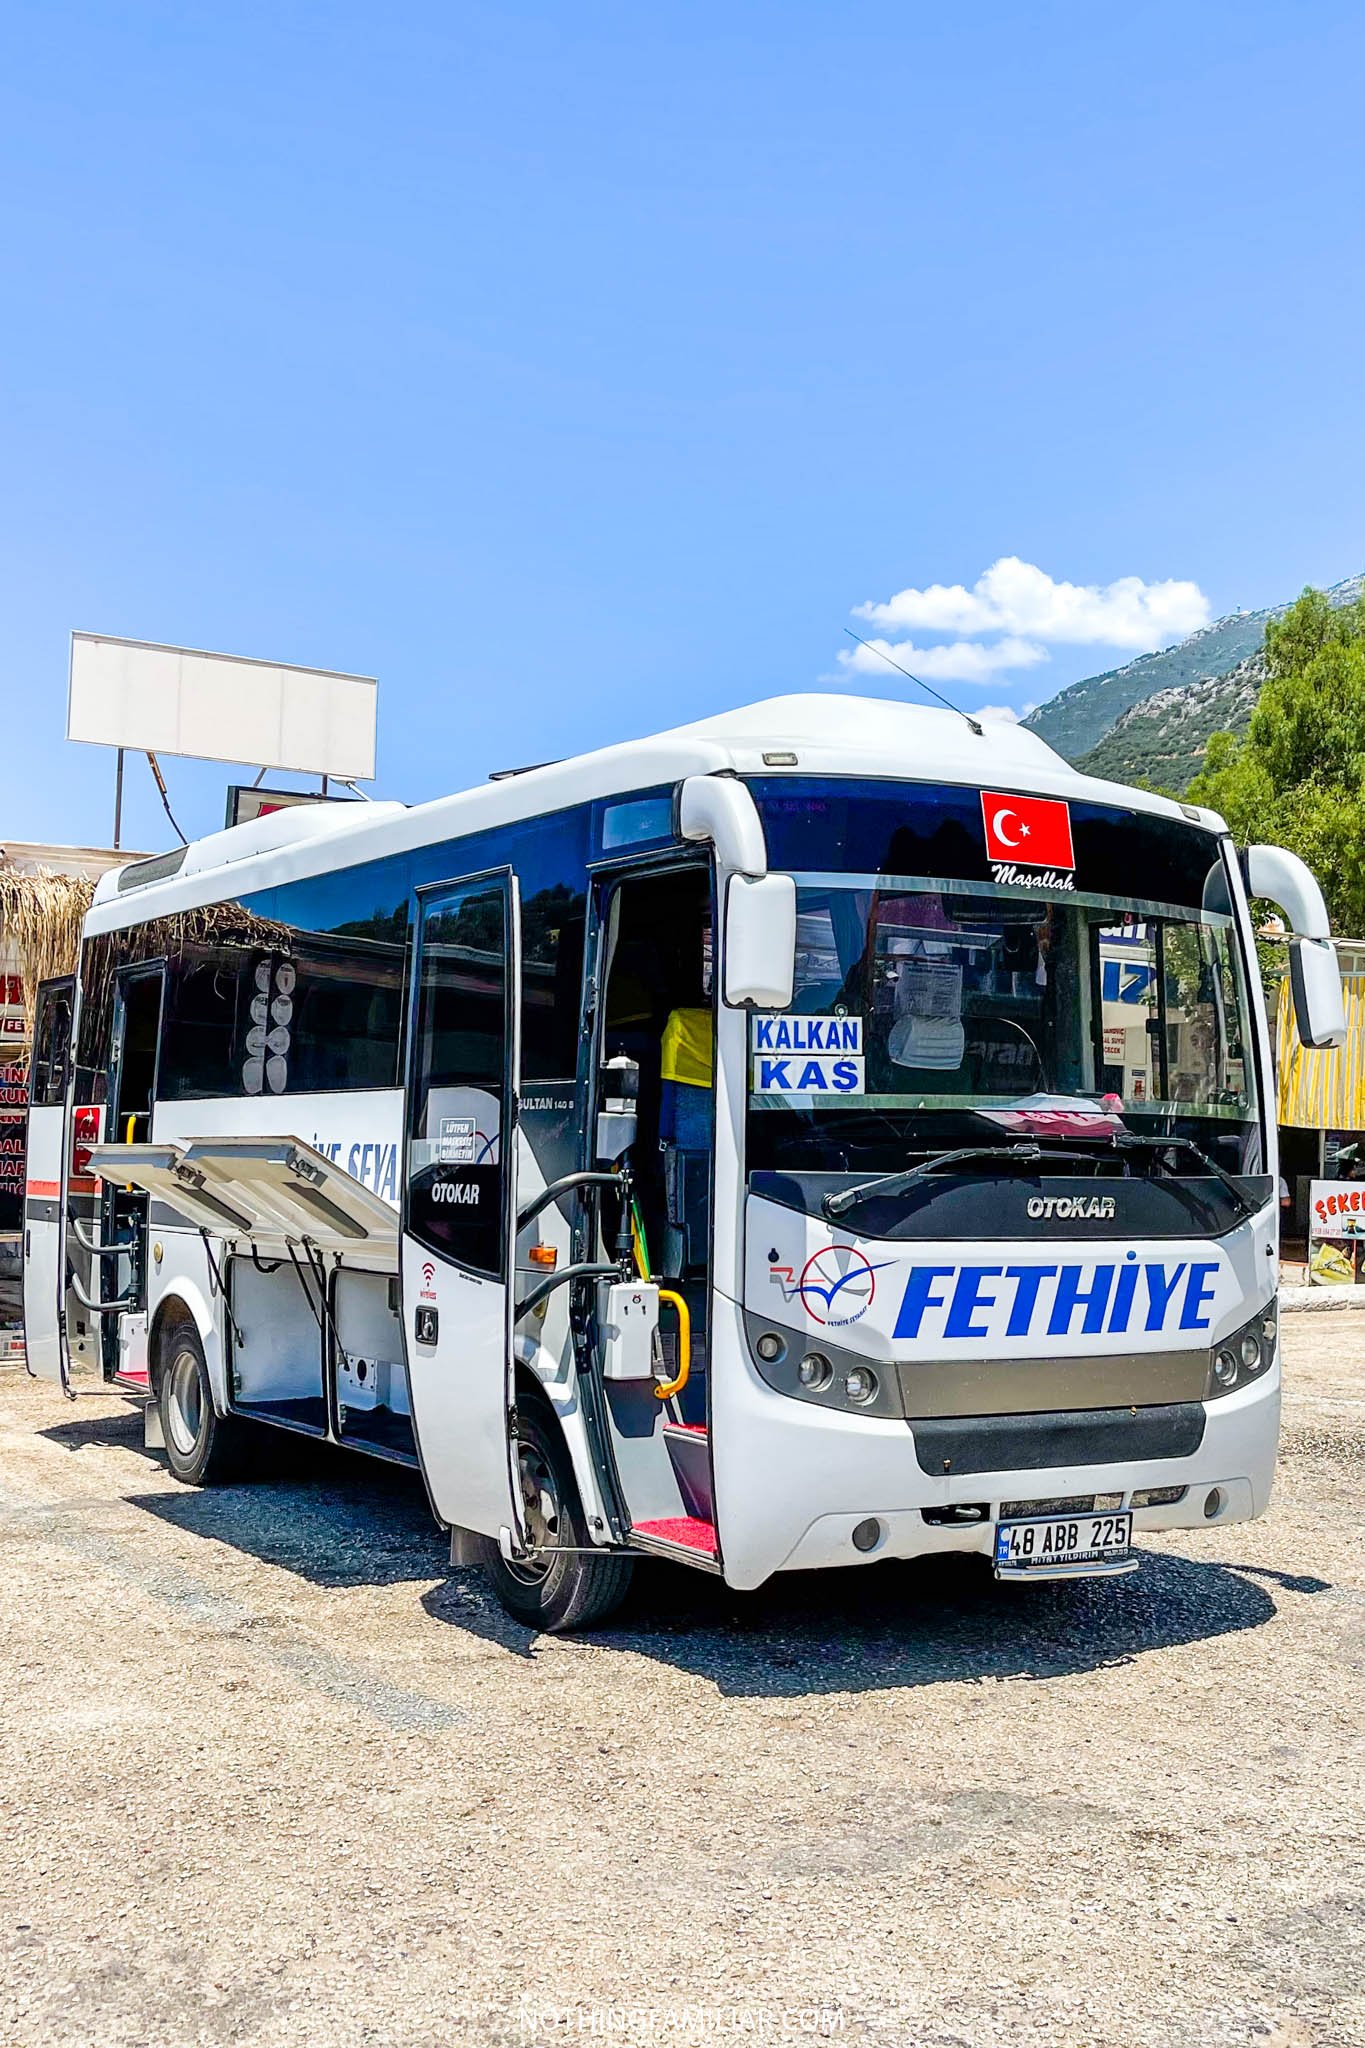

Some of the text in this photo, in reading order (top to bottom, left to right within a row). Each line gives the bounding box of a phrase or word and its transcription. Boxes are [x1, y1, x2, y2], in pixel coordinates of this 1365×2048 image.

[991, 864, 1075, 891] Maşallah
[7, 1020, 25, 1031] FE
[757, 1020, 858, 1050] KALKAN
[761, 1061, 858, 1093] KAŞ
[348, 1143, 400, 1201] SEYA
[431, 1182, 480, 1205] OTOKAR
[1027, 1196, 1116, 1218] OTOKAR
[892, 1250, 1220, 1339] FETHİYE
[999, 1546, 1009, 1554] TR
[1010, 1518, 1126, 1556] 48 ABB 225
